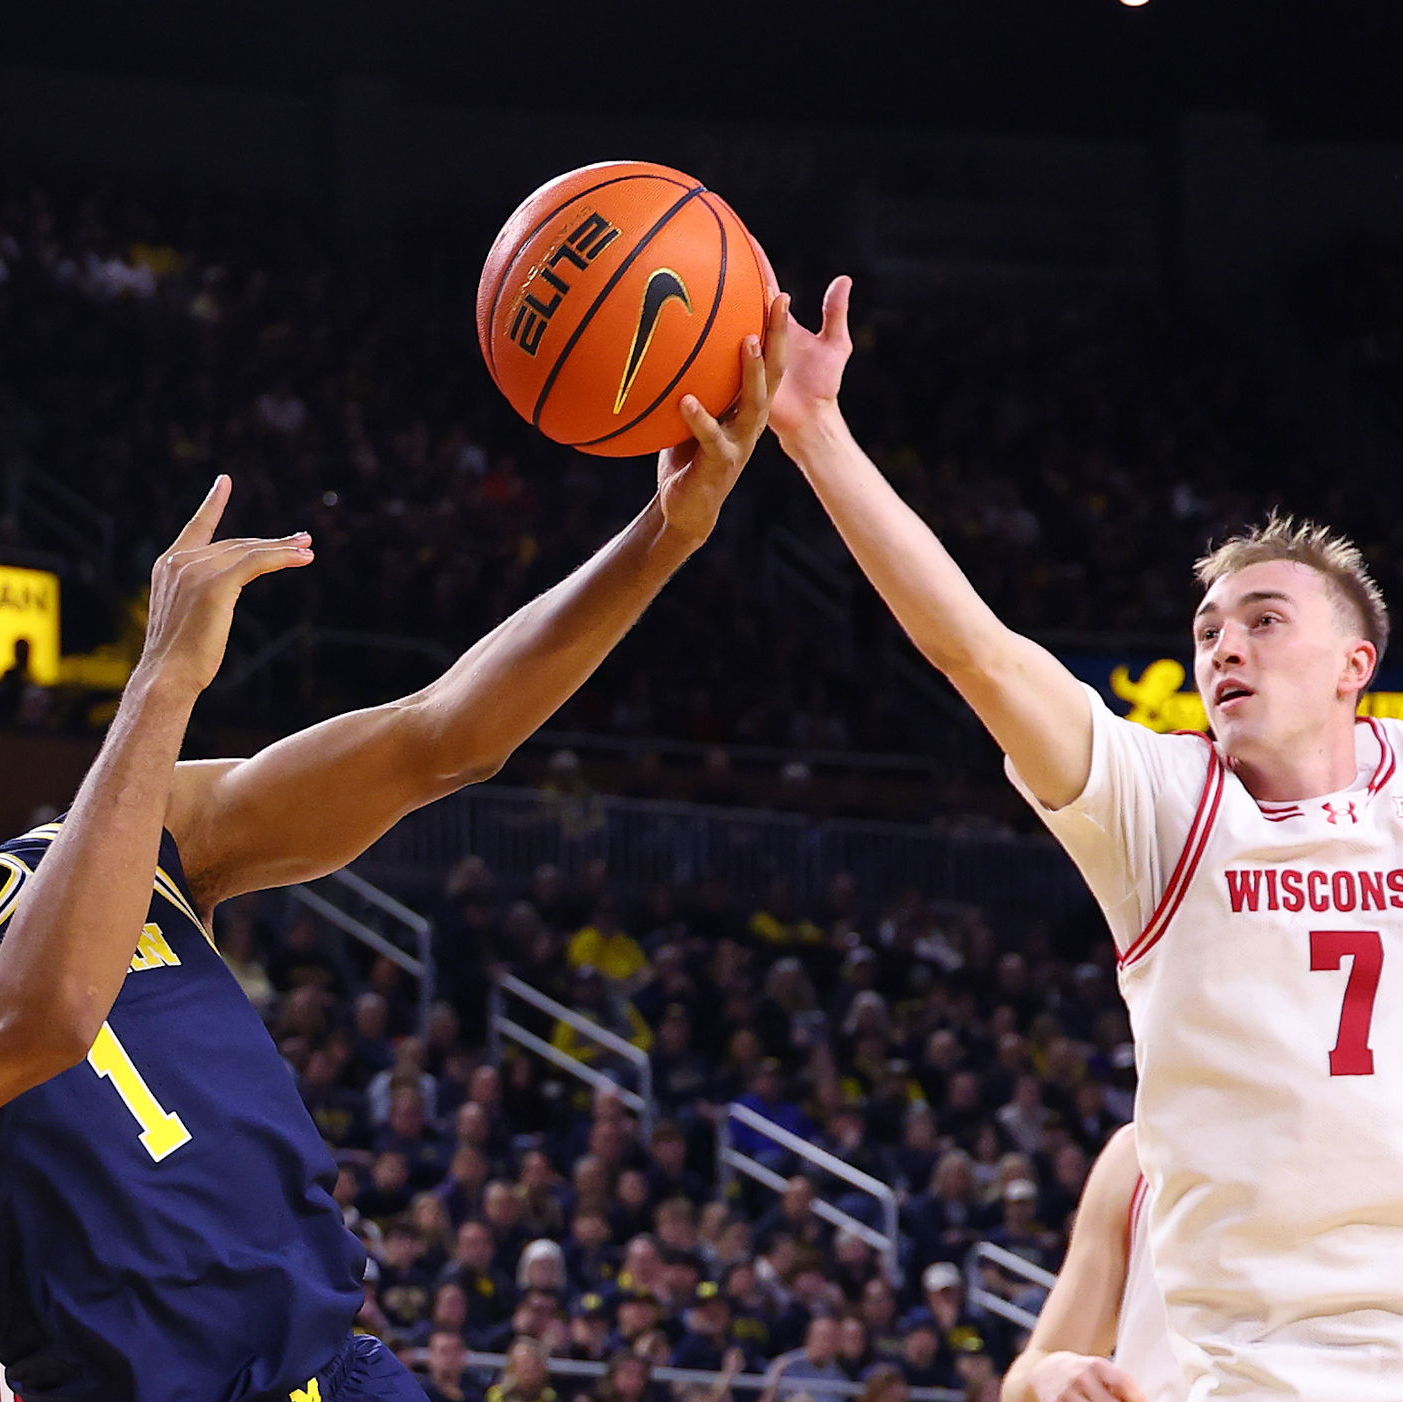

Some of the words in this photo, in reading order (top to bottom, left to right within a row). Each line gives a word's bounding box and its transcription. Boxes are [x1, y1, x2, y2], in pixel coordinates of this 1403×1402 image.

[510, 212, 622, 357] ELITE
[1309, 931, 1385, 1077] 7
[86, 1020, 193, 1163] 1
